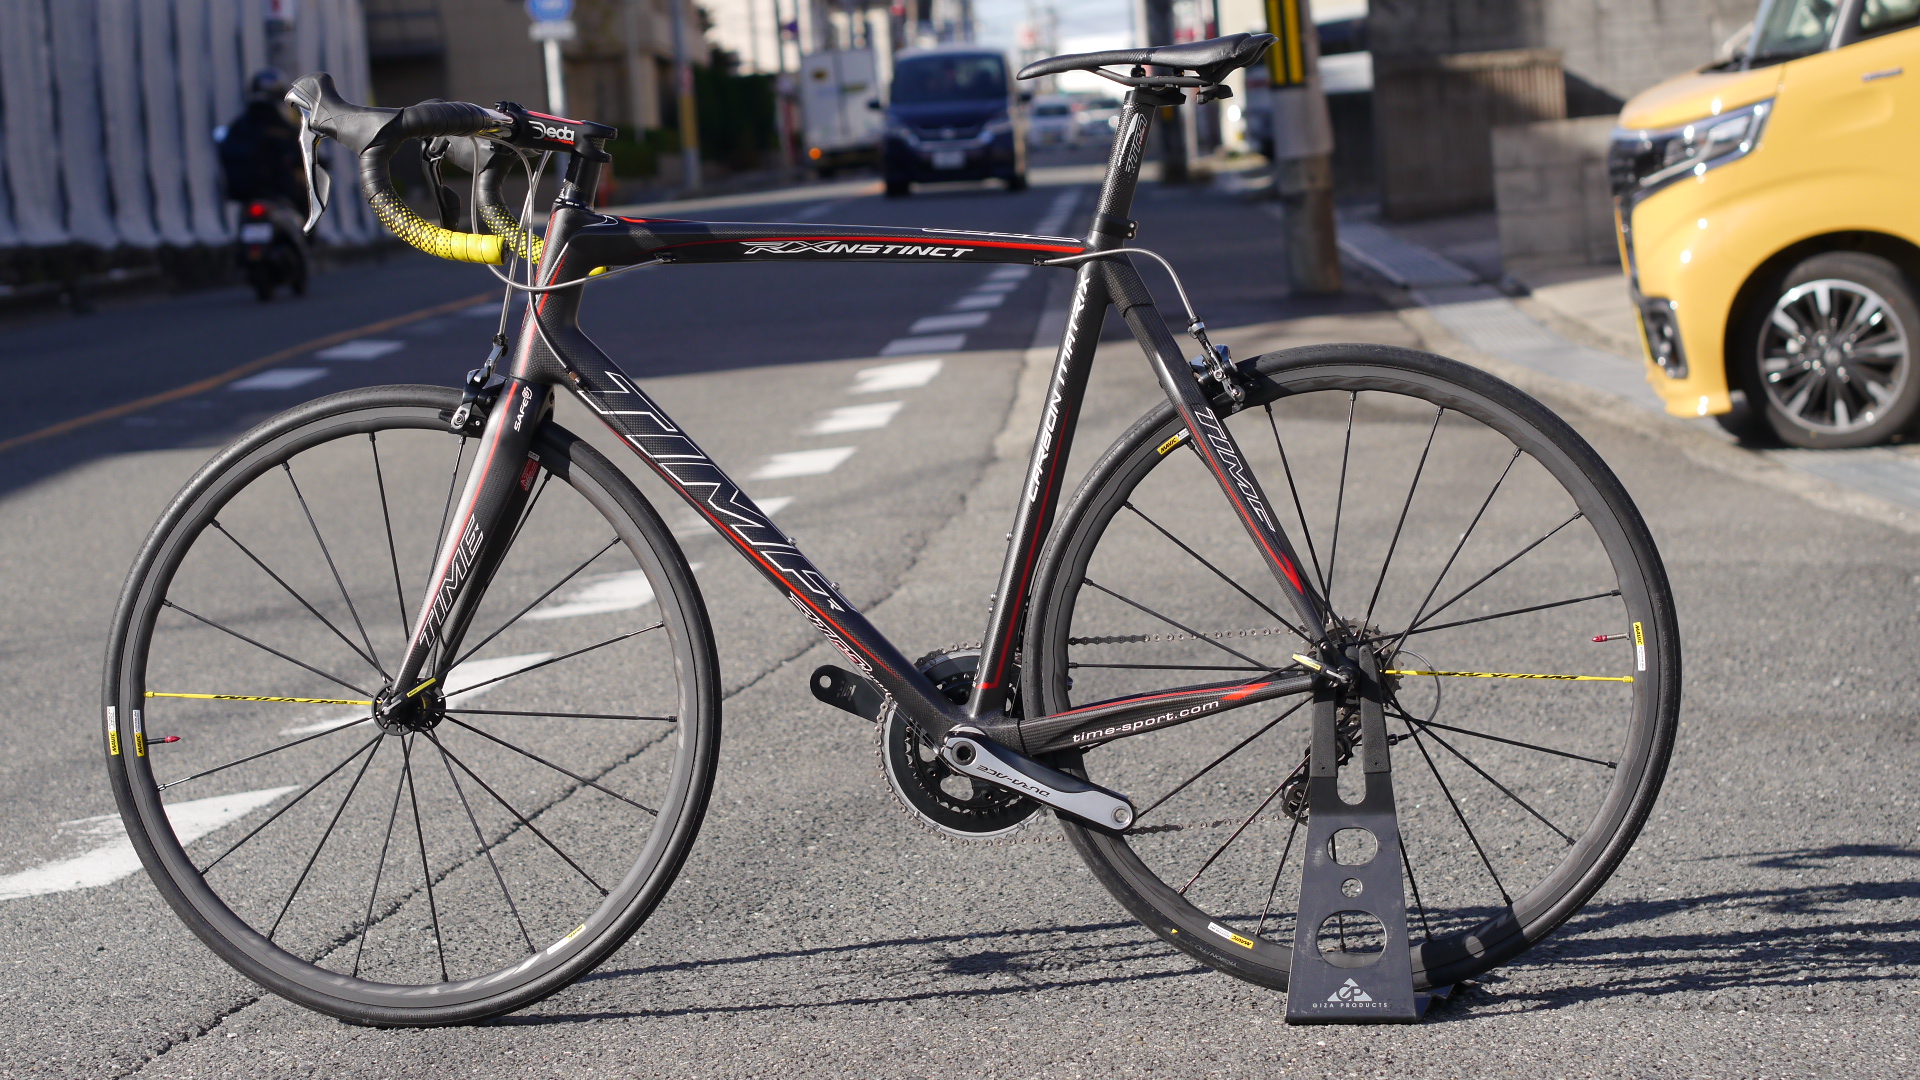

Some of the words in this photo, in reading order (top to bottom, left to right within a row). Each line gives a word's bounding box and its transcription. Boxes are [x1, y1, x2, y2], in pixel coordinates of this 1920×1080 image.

[528, 120, 575, 141] Deda
[828, 243, 974, 258] INSTINCT
[1027, 389, 1063, 502] CARBON
[1056, 271, 1090, 386] MATRIX
[1159, 436, 1177, 454] MAVIC
[1194, 406, 1276, 532] TIME
[419, 512, 484, 649] TIME
[1634, 623, 1643, 645] MAVIC
[1072, 700, 1220, 743] time-sport.com
[109, 732, 118, 753] MAVIC
[135, 734, 144, 755] MAVIC
[976, 764, 1051, 798] DURA-ACE
[1230, 935, 1252, 947] MAVIC
